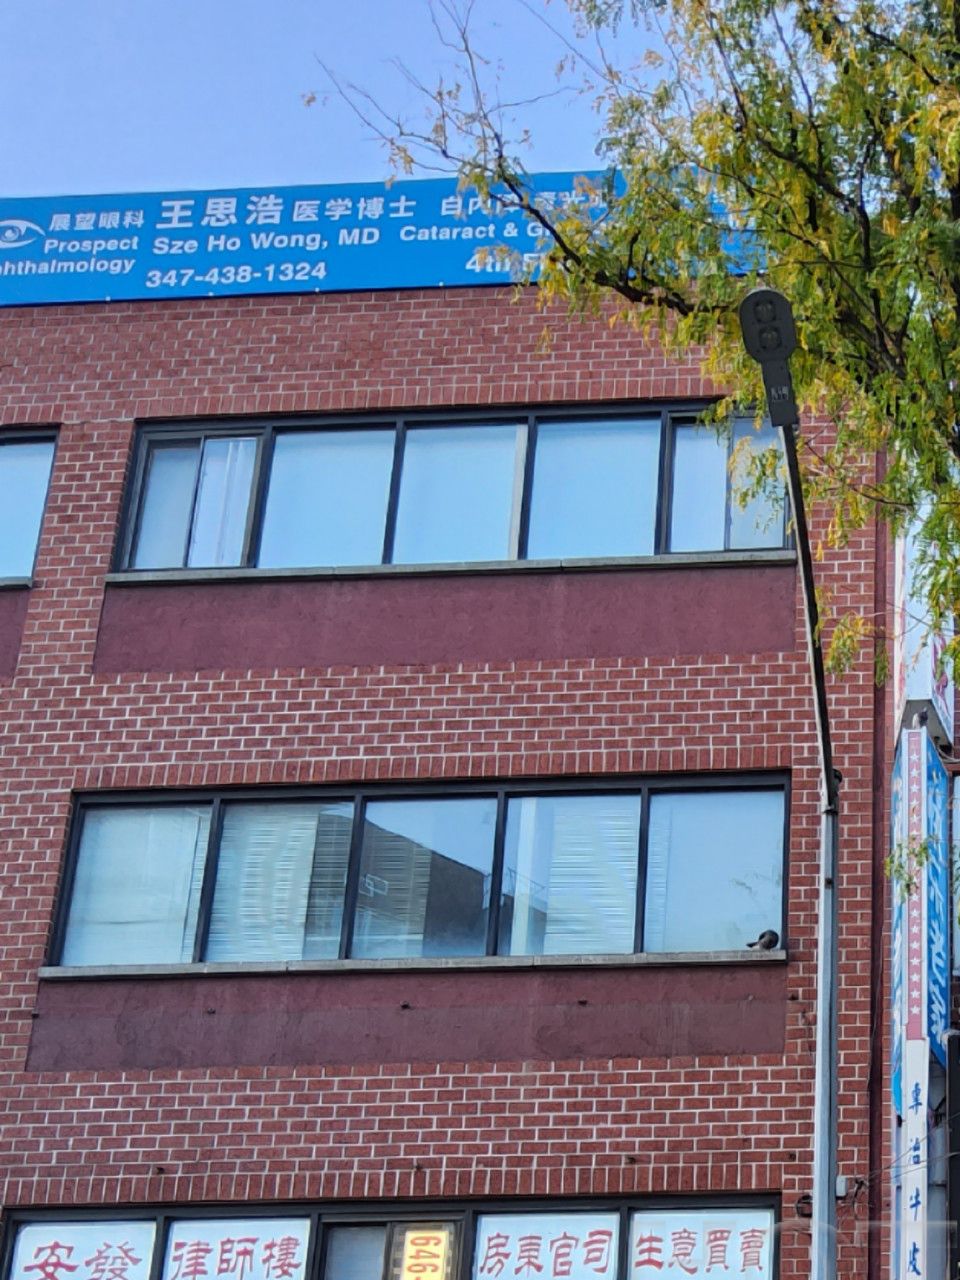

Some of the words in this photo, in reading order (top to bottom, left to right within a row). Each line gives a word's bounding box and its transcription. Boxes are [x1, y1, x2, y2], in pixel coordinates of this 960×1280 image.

[49, 210, 145, 232] 展望眼科
[44, 236, 139, 254] Prospect
[152, 237, 198, 255] Sze
[208, 234, 241, 252] Ho
[251, 231, 328, 251] Wong,
[338, 227, 380, 246] MD
[400, 223, 495, 242] Cataract
[503, 222, 519, 238] &
[0, 257, 136, 277] hthalmology
[146, 262, 327, 288] 347-438-1324
